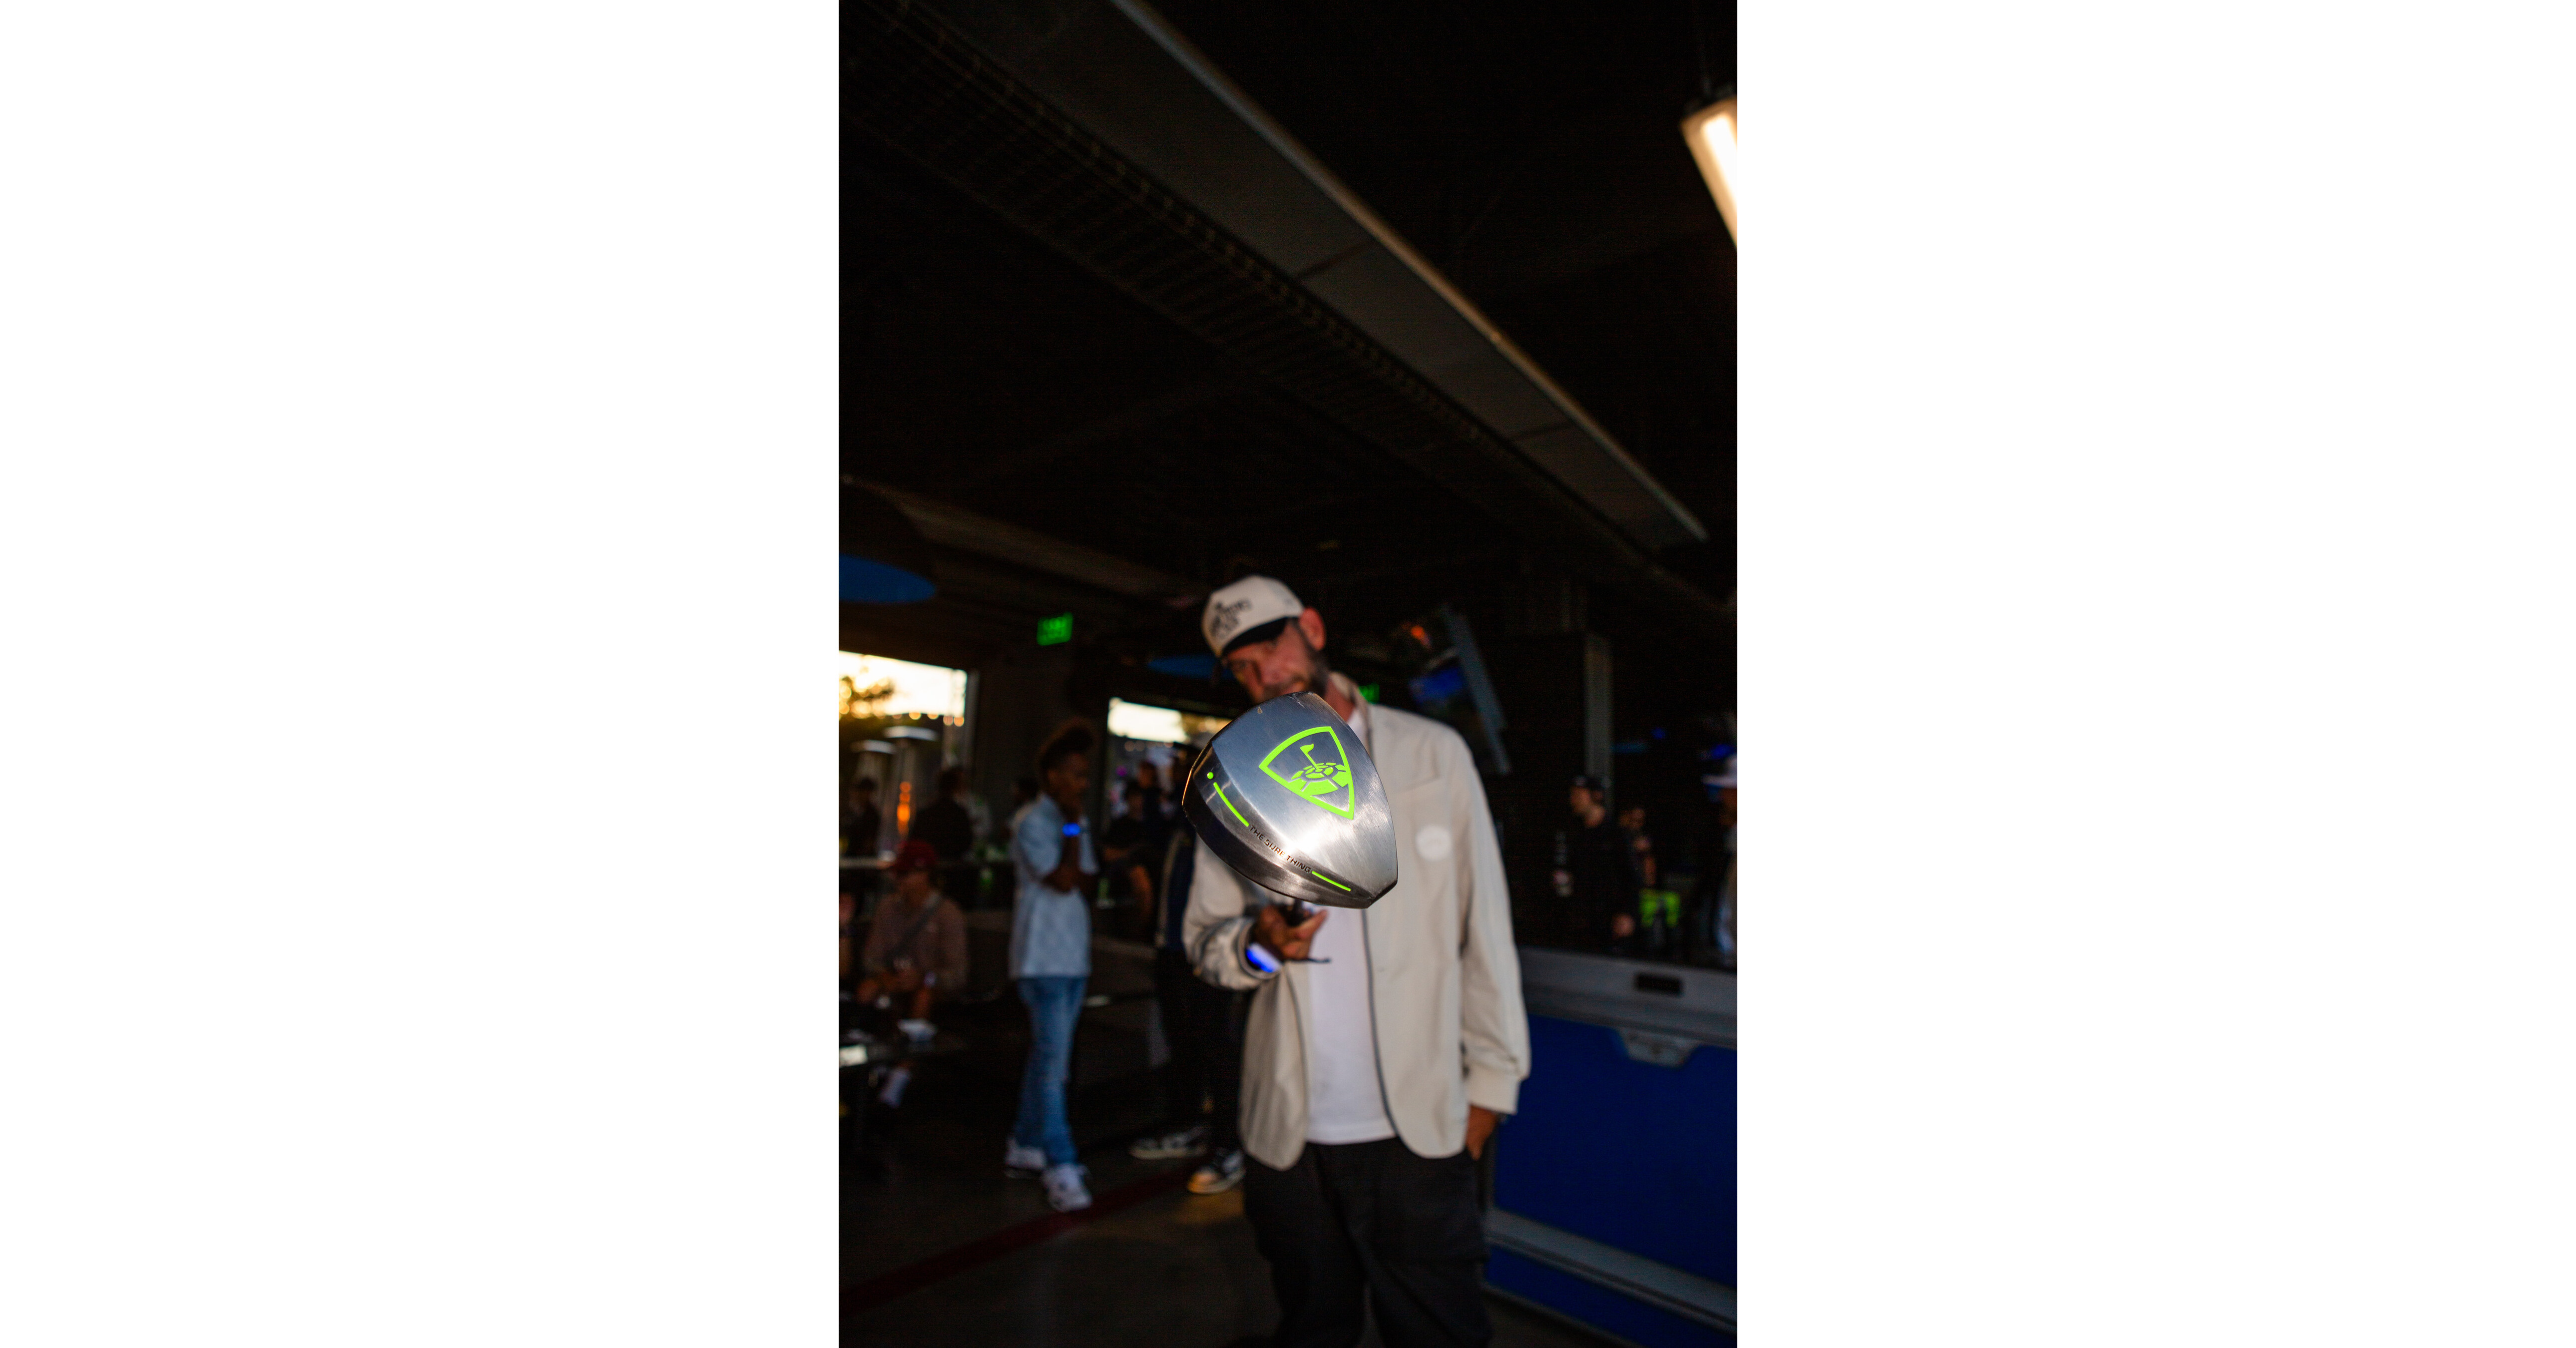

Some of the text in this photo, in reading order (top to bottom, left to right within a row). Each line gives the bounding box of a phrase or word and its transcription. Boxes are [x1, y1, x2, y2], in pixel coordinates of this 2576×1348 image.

[1250, 826, 1311, 873] THE SURE THING
